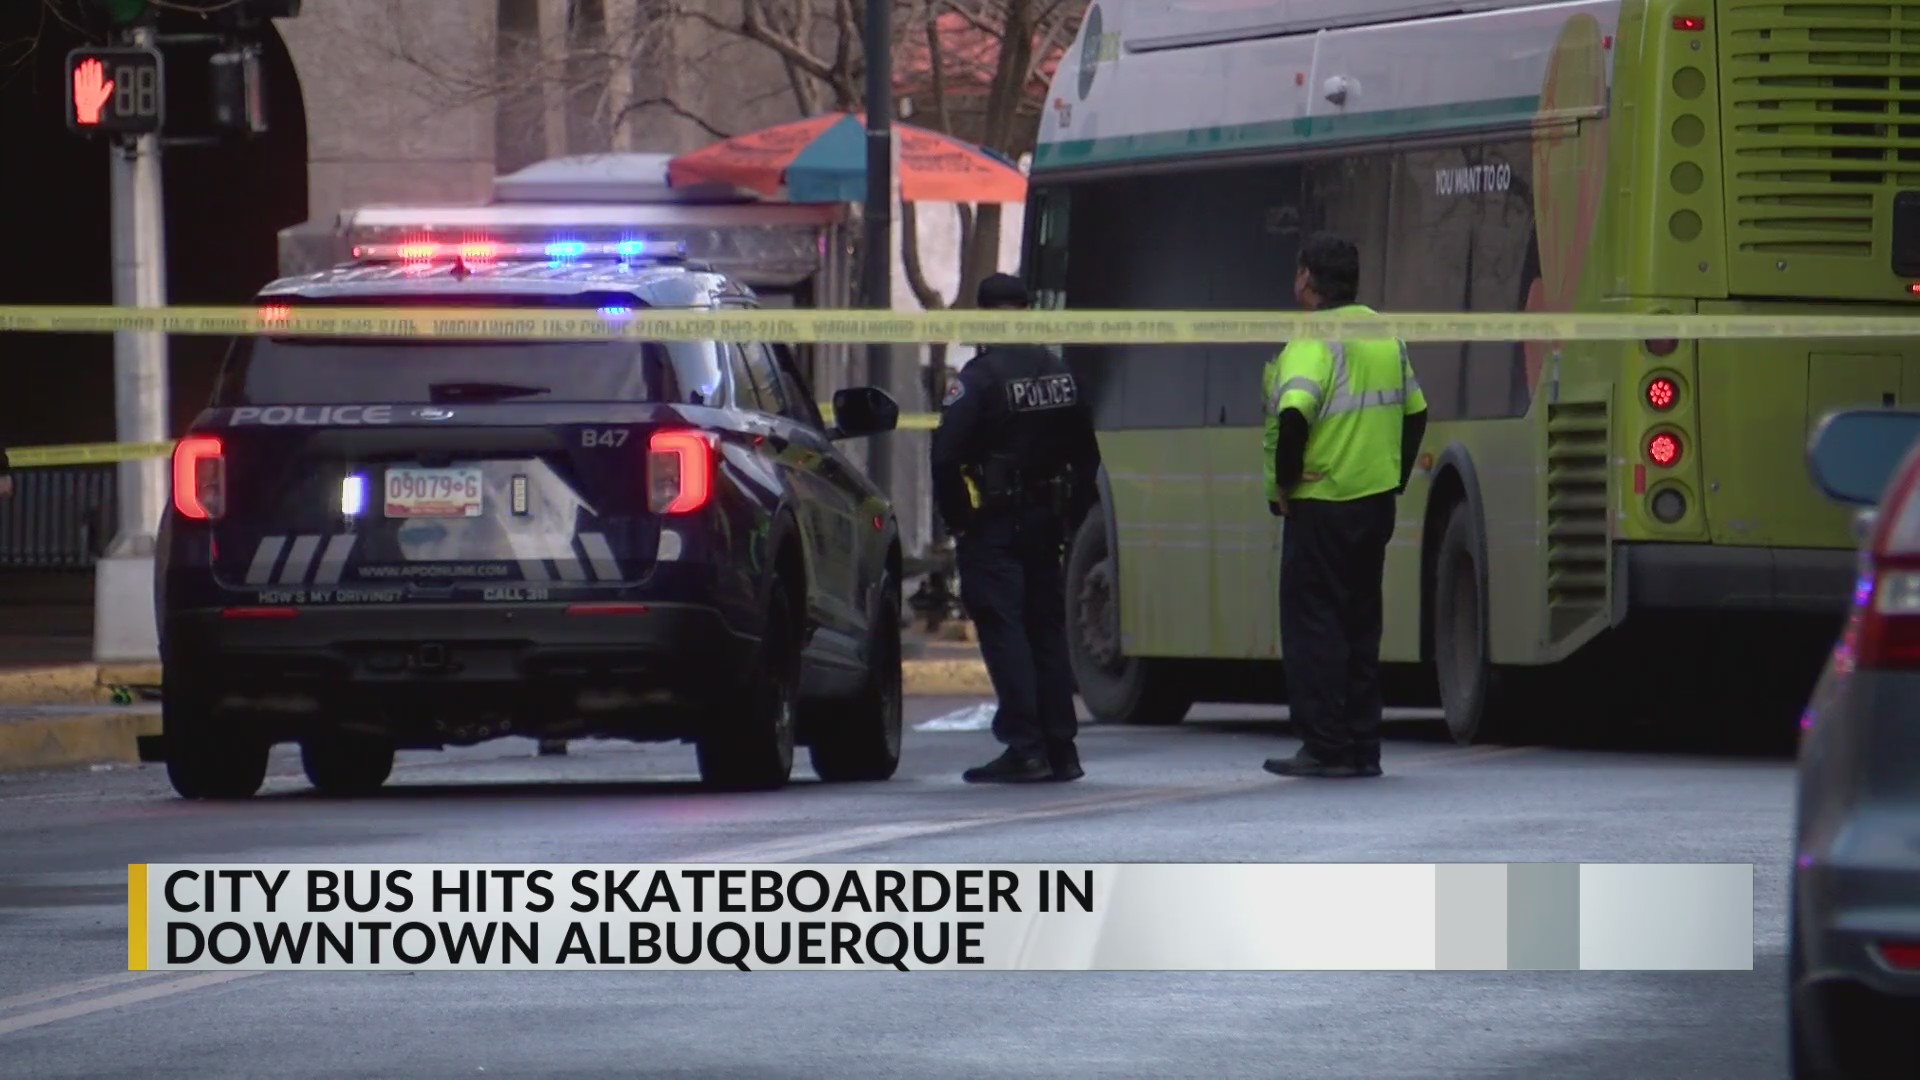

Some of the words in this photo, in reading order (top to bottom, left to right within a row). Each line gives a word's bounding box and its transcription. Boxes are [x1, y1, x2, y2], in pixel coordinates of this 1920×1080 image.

[1435, 167, 1454, 196] YOU
[1454, 165, 1481, 194] WANT
[1483, 164, 1495, 192] TO
[1496, 162, 1511, 191] GO
[1013, 378, 1072, 406] POLICE
[228, 405, 392, 426] POLICE
[581, 428, 629, 448] B47
[258, 590, 305, 603] HOW'S
[310, 590, 333, 603] MY
[336, 590, 404, 603] DRIVING?
[482, 588, 523, 601] CALL
